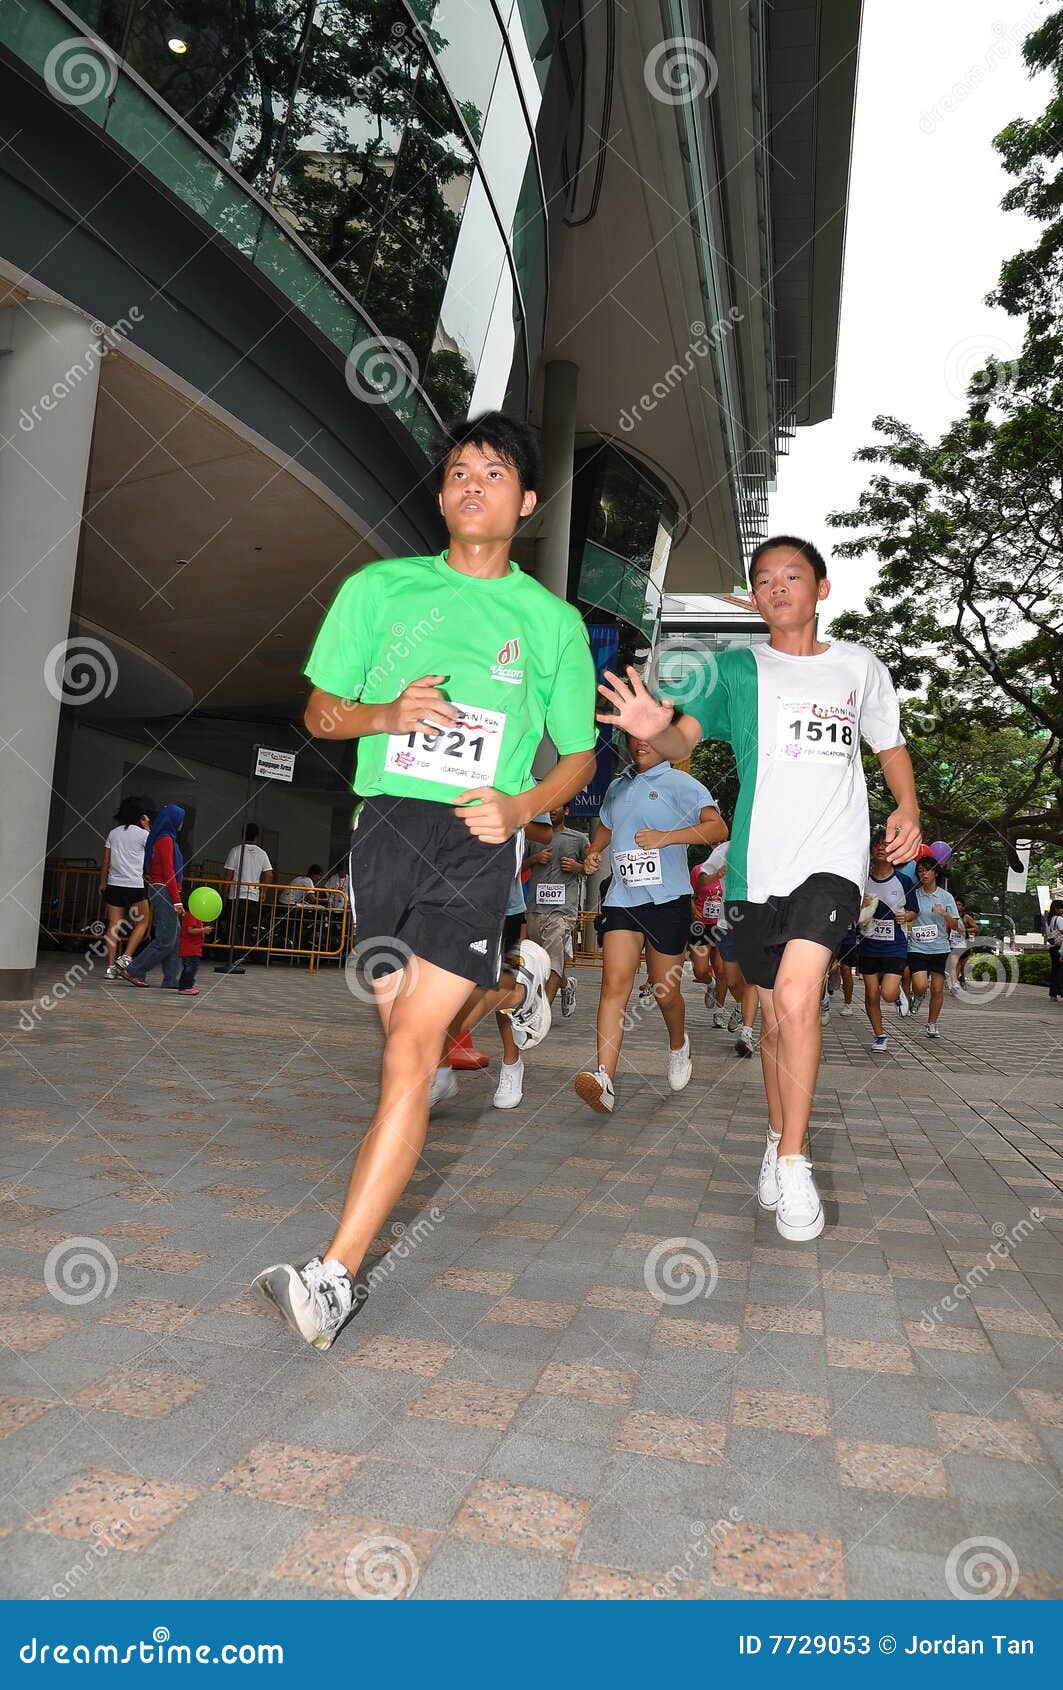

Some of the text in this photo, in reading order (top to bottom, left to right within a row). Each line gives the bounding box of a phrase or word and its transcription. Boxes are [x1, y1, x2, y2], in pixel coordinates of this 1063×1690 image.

[789, 720, 852, 746] 1518
[407, 731, 485, 762] 1921
[258, 759, 292, 772] Baggage Area
[575, 795, 601, 806] SMU
[620, 861, 656, 877] 0170
[539, 890, 562, 898] 0607
[874, 926, 892, 935] 475
[915, 930, 936, 939] 0425
